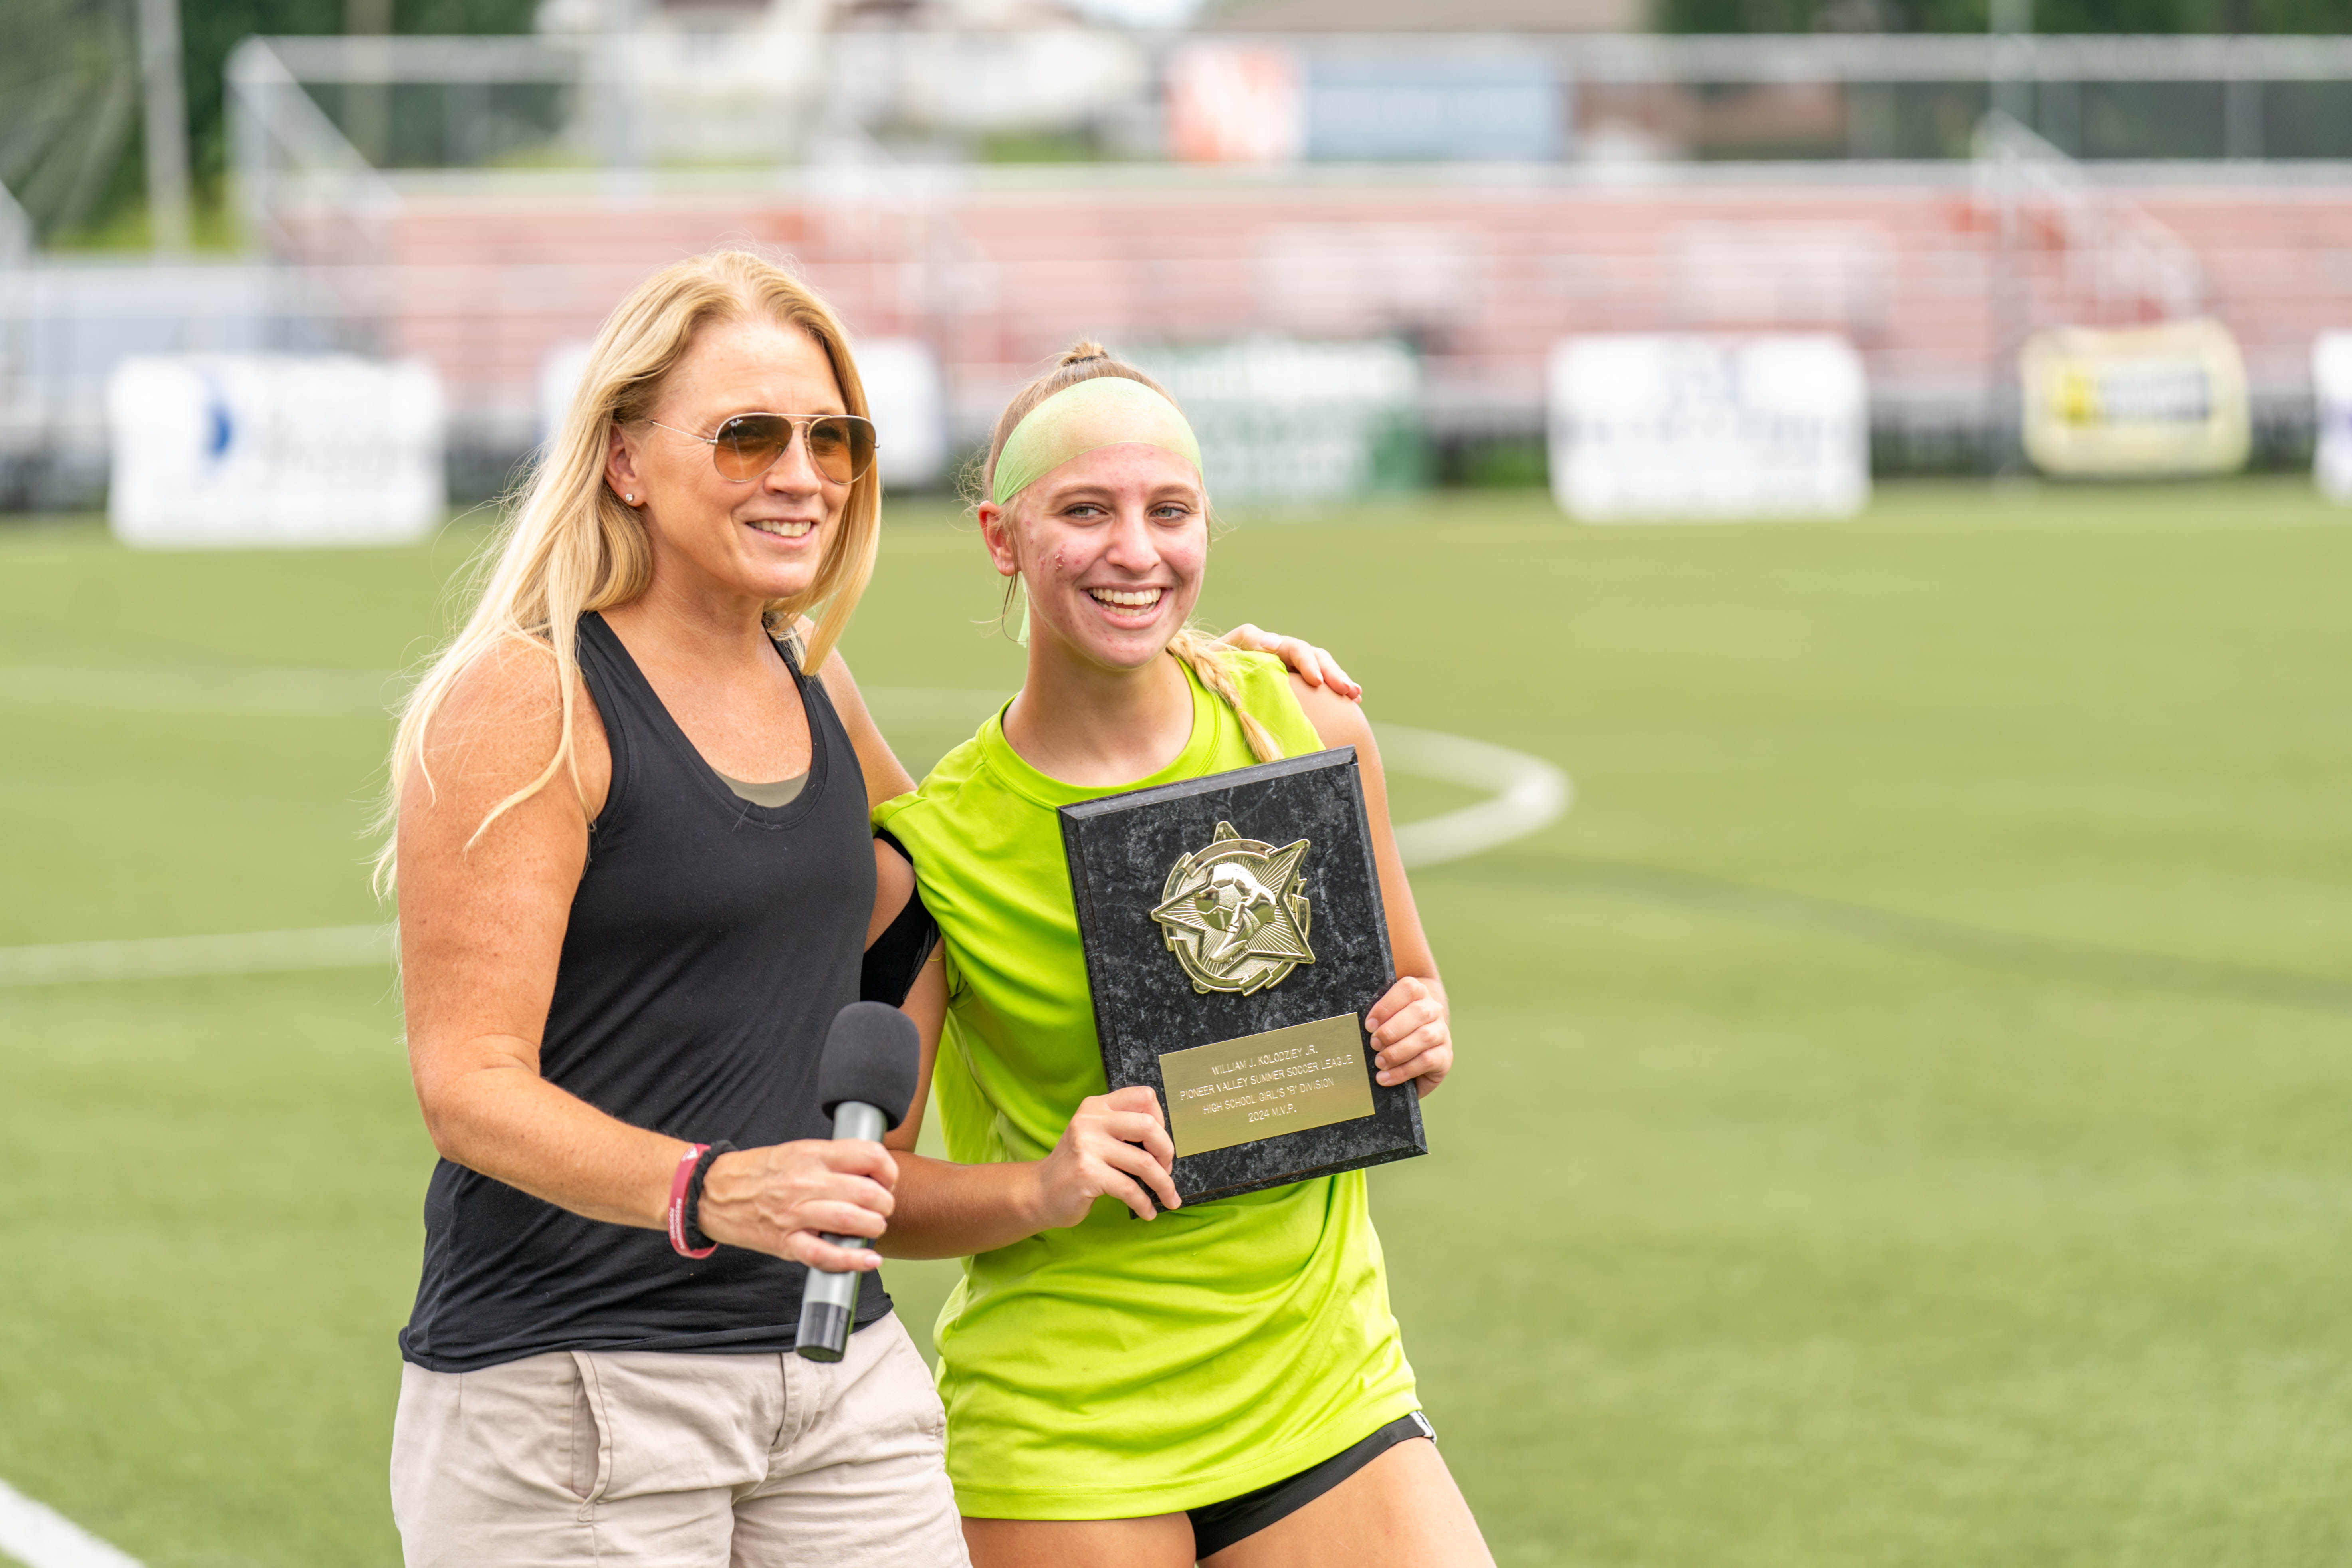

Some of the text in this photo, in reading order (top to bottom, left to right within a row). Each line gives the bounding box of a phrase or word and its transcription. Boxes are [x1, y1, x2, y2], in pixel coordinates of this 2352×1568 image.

[1211, 1045, 1318, 1075] WILLIAM J. KOLODZIEY JR.
[1180, 1054, 1353, 1100] PIONEER VALLEY SUMMER SOCCER LEAGUE
[1203, 1102, 1223, 1114] HIGH
[1225, 1095, 1257, 1109] SCHOOL
[1259, 1088, 1285, 1102] GIRL'S
[1300, 1077, 1334, 1093] DIVISION
[1248, 1104, 1297, 1122] 2024 M.V.P.
